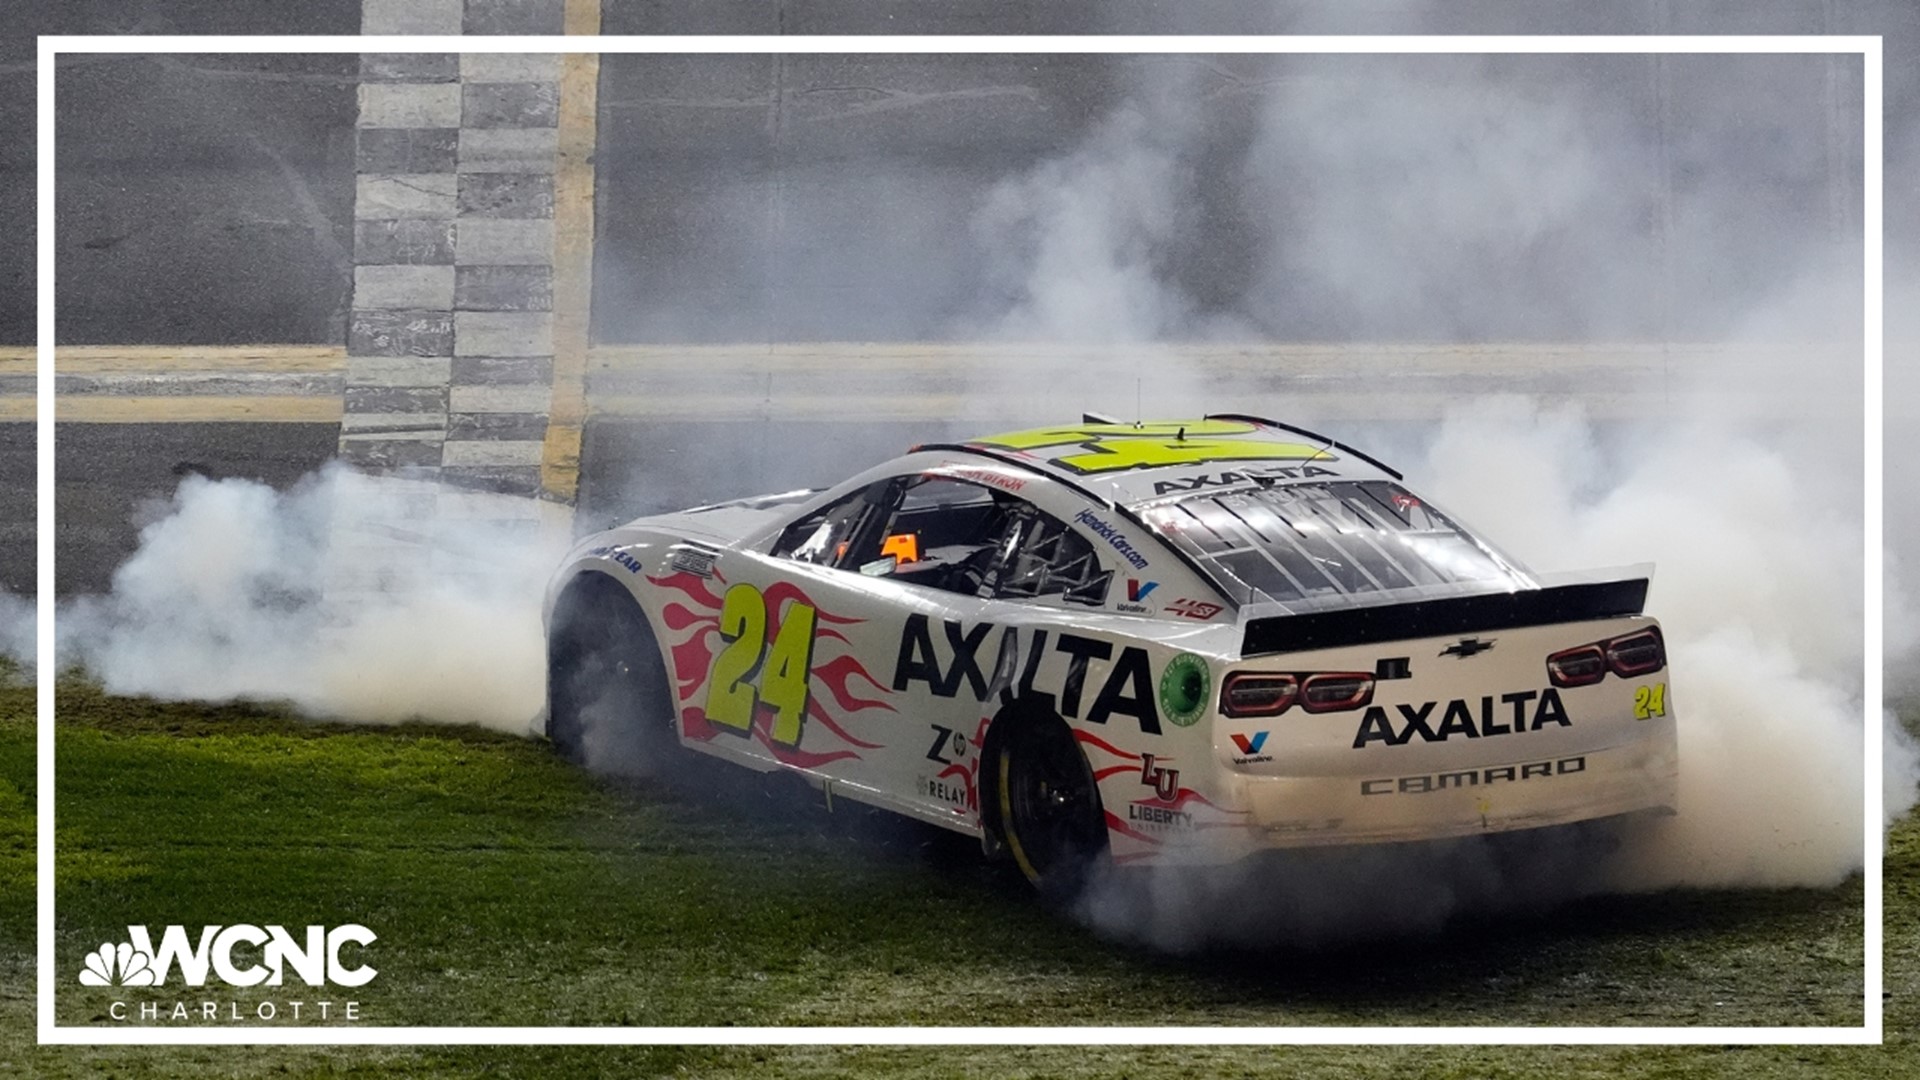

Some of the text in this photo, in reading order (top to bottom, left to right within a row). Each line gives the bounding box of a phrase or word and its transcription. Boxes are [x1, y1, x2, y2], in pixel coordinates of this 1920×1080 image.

[705, 583, 819, 752] 24
[893, 613, 1163, 736] AXALTA
[1352, 688, 1572, 748] AXALTA
[1634, 683, 1666, 720] 24
[929, 781, 965, 806] RELAY
[1361, 756, 1586, 796] CAMARO
[1129, 804, 1193, 827] LIBERTY
